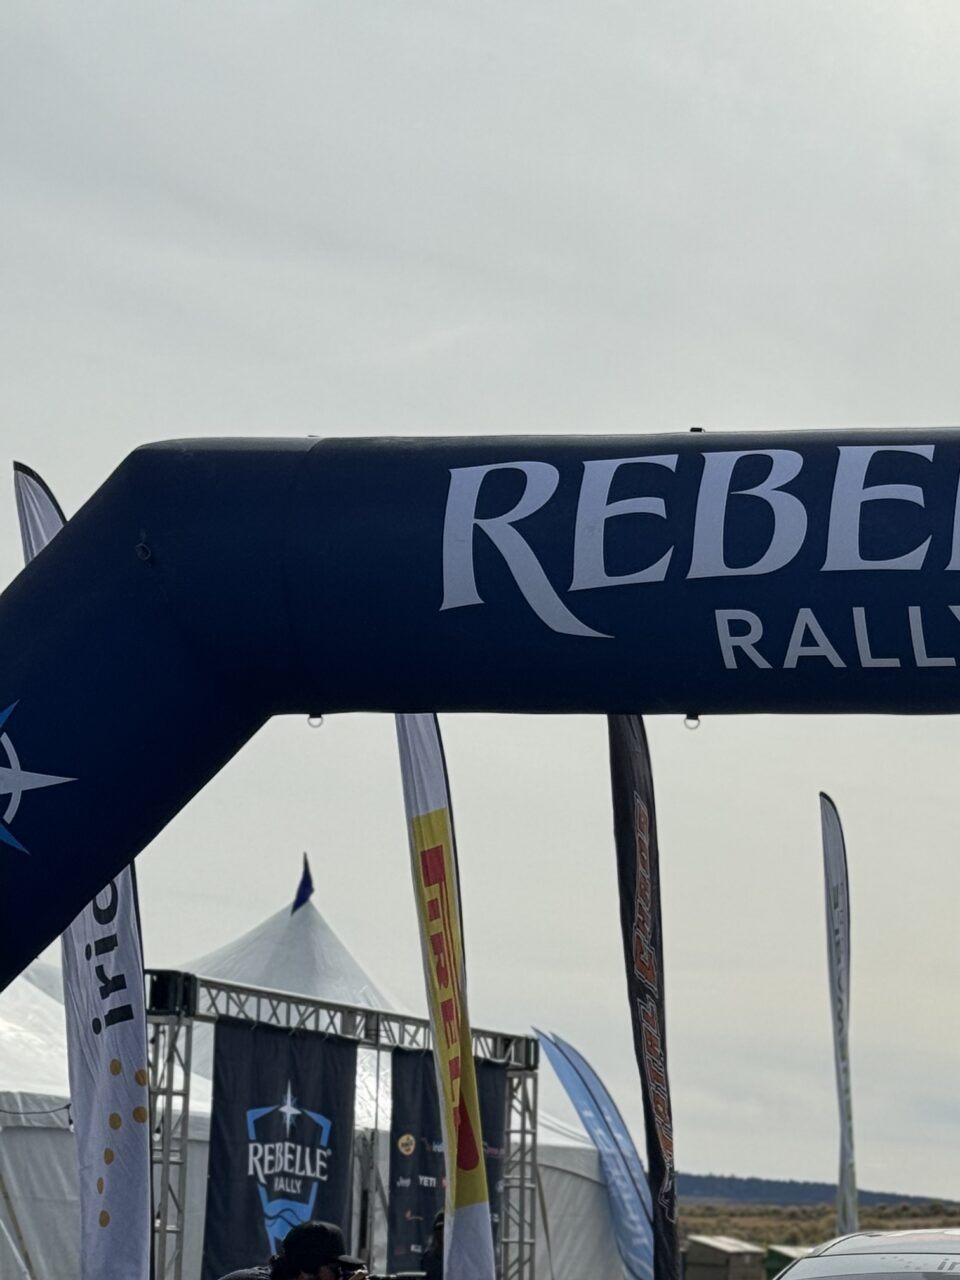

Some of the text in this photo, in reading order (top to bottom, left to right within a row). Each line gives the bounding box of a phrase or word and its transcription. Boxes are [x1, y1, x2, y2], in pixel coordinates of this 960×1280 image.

[420, 845, 461, 1136] PIREL
[248, 1141, 328, 1184] REBELLE
[419, 1175, 437, 1187] YETI
